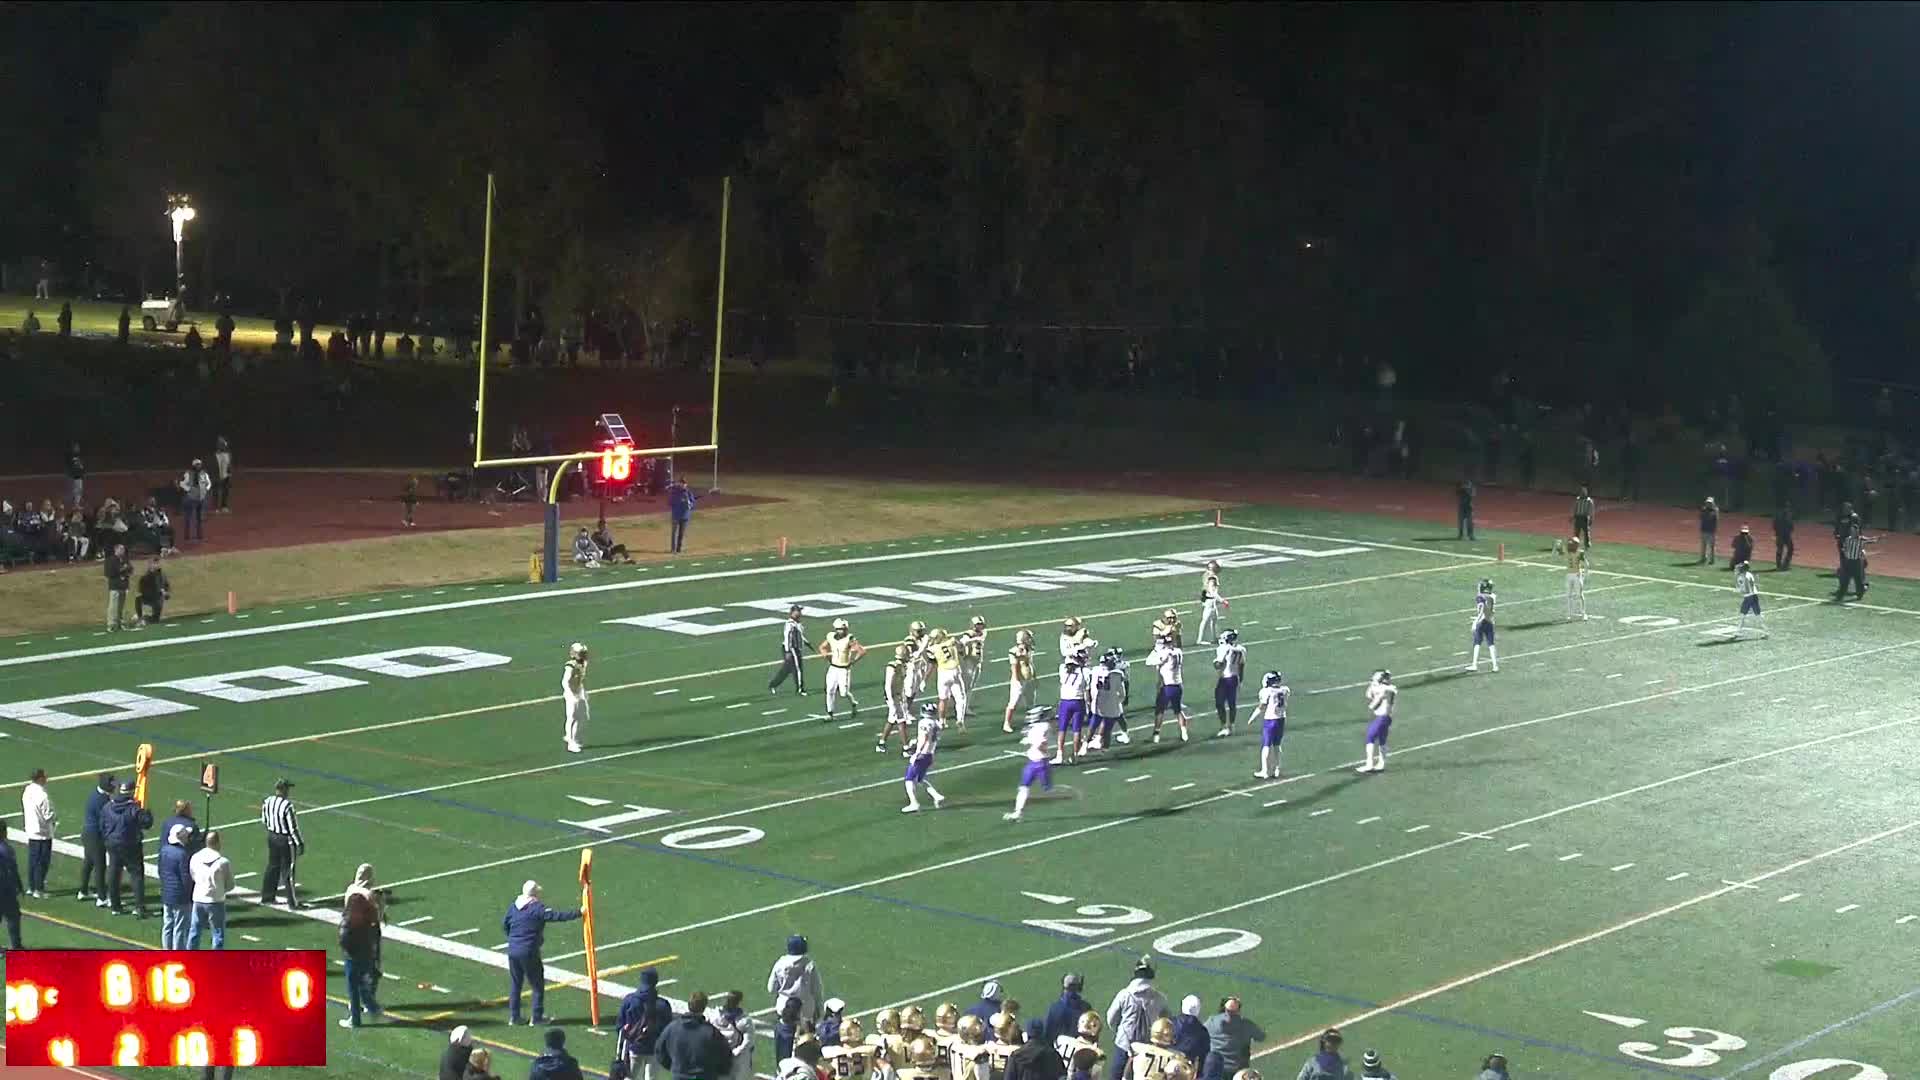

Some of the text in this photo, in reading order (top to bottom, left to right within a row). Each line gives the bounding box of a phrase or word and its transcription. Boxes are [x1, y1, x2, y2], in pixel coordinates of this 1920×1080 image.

[0, 543, 1374, 738] OOD COUNSEL
[557, 804, 766, 849] 10
[1021, 904, 1262, 959] 20
